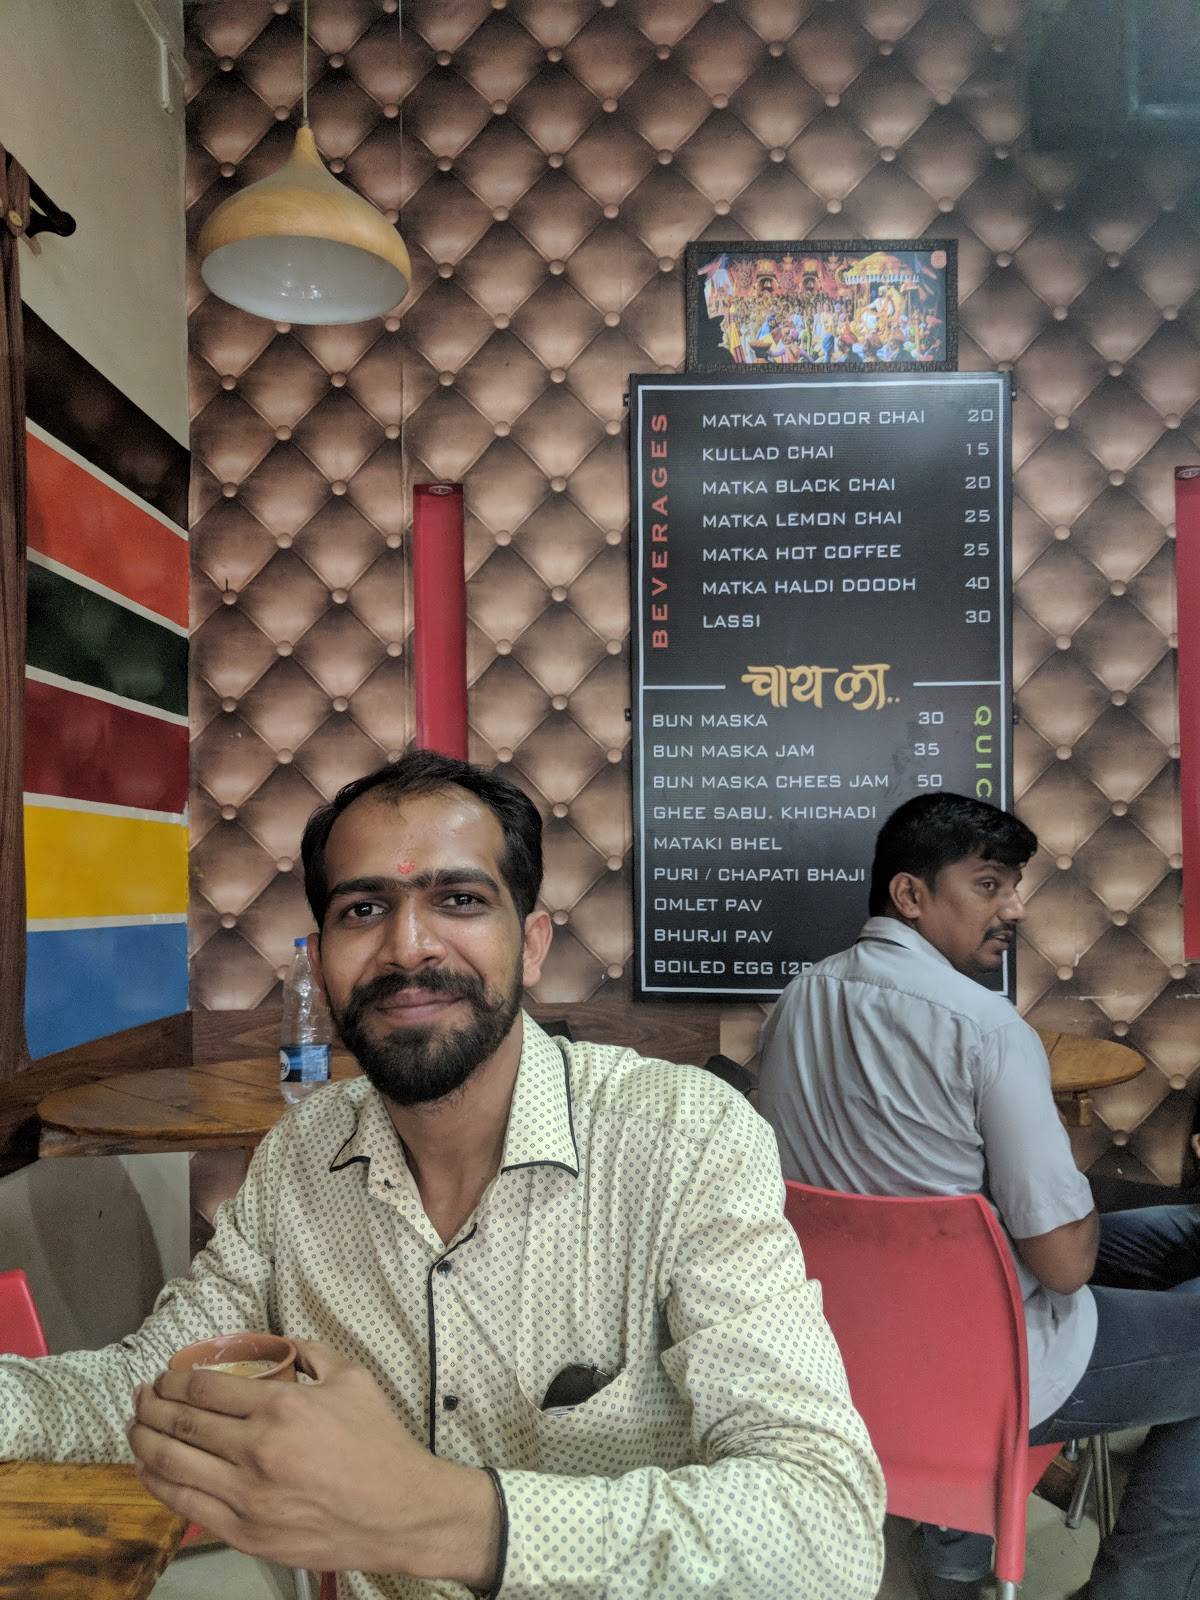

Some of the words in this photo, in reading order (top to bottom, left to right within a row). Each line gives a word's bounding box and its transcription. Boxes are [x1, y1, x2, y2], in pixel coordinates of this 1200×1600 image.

[702, 413, 768, 429] MATKA
[773, 411, 871, 427] TANDOOR
[878, 410, 925, 425] CHAI
[967, 409, 994, 422] 20
[702, 446, 780, 462] KULLAD
[787, 445, 834, 460] CHAI
[966, 442, 990, 456] 15
[702, 480, 769, 496] MATKA
[775, 478, 841, 494] BLACK
[848, 477, 896, 492] CHAI
[964, 475, 991, 490] 20
[702, 513, 769, 529] MATKA
[775, 511, 846, 527] LEMON
[854, 510, 902, 526] CHAI
[964, 509, 991, 523] 25
[651, 414, 669, 649] BEVERAGES
[702, 547, 769, 562] MATKA
[775, 545, 818, 561] HOT
[824, 544, 902, 560] COFFEE
[963, 542, 990, 557] 25
[702, 580, 768, 596] MATKA
[774, 579, 834, 594] HALDI
[842, 577, 916, 593] DOODH
[964, 576, 990, 590] 40
[702, 613, 761, 629] LASSI
[965, 609, 991, 624] 30
[652, 714, 693, 728] BUN
[701, 713, 769, 728] MASKA
[918, 711, 944, 725] 30
[653, 744, 693, 758] BUN
[701, 744, 769, 758] MASKA
[775, 743, 815, 758] JAM
[913, 742, 940, 756] 35
[653, 775, 694, 789] BUN
[701, 775, 769, 789] MASKA
[775, 774, 841, 789] CHEES
[849, 774, 889, 788] JAM
[917, 773, 943, 788] 50
[653, 806, 707, 820] GHEE
[713, 806, 773, 820] SABU.
[781, 805, 876, 820] KHICHADI
[653, 836, 722, 850] MATAKI
[730, 837, 783, 851] BHEL
[653, 867, 699, 881] PURI
[704, 867, 712, 881] /
[718, 868, 799, 882] CHAPATI
[807, 868, 865, 882] BHAJI
[653, 897, 719, 912] OMLET
[725, 898, 763, 912] PAV
[654, 928, 727, 943] BHURJI
[735, 929, 774, 944] PAV
[654, 959, 726, 975] BOILED
[733, 961, 774, 975] EGG
